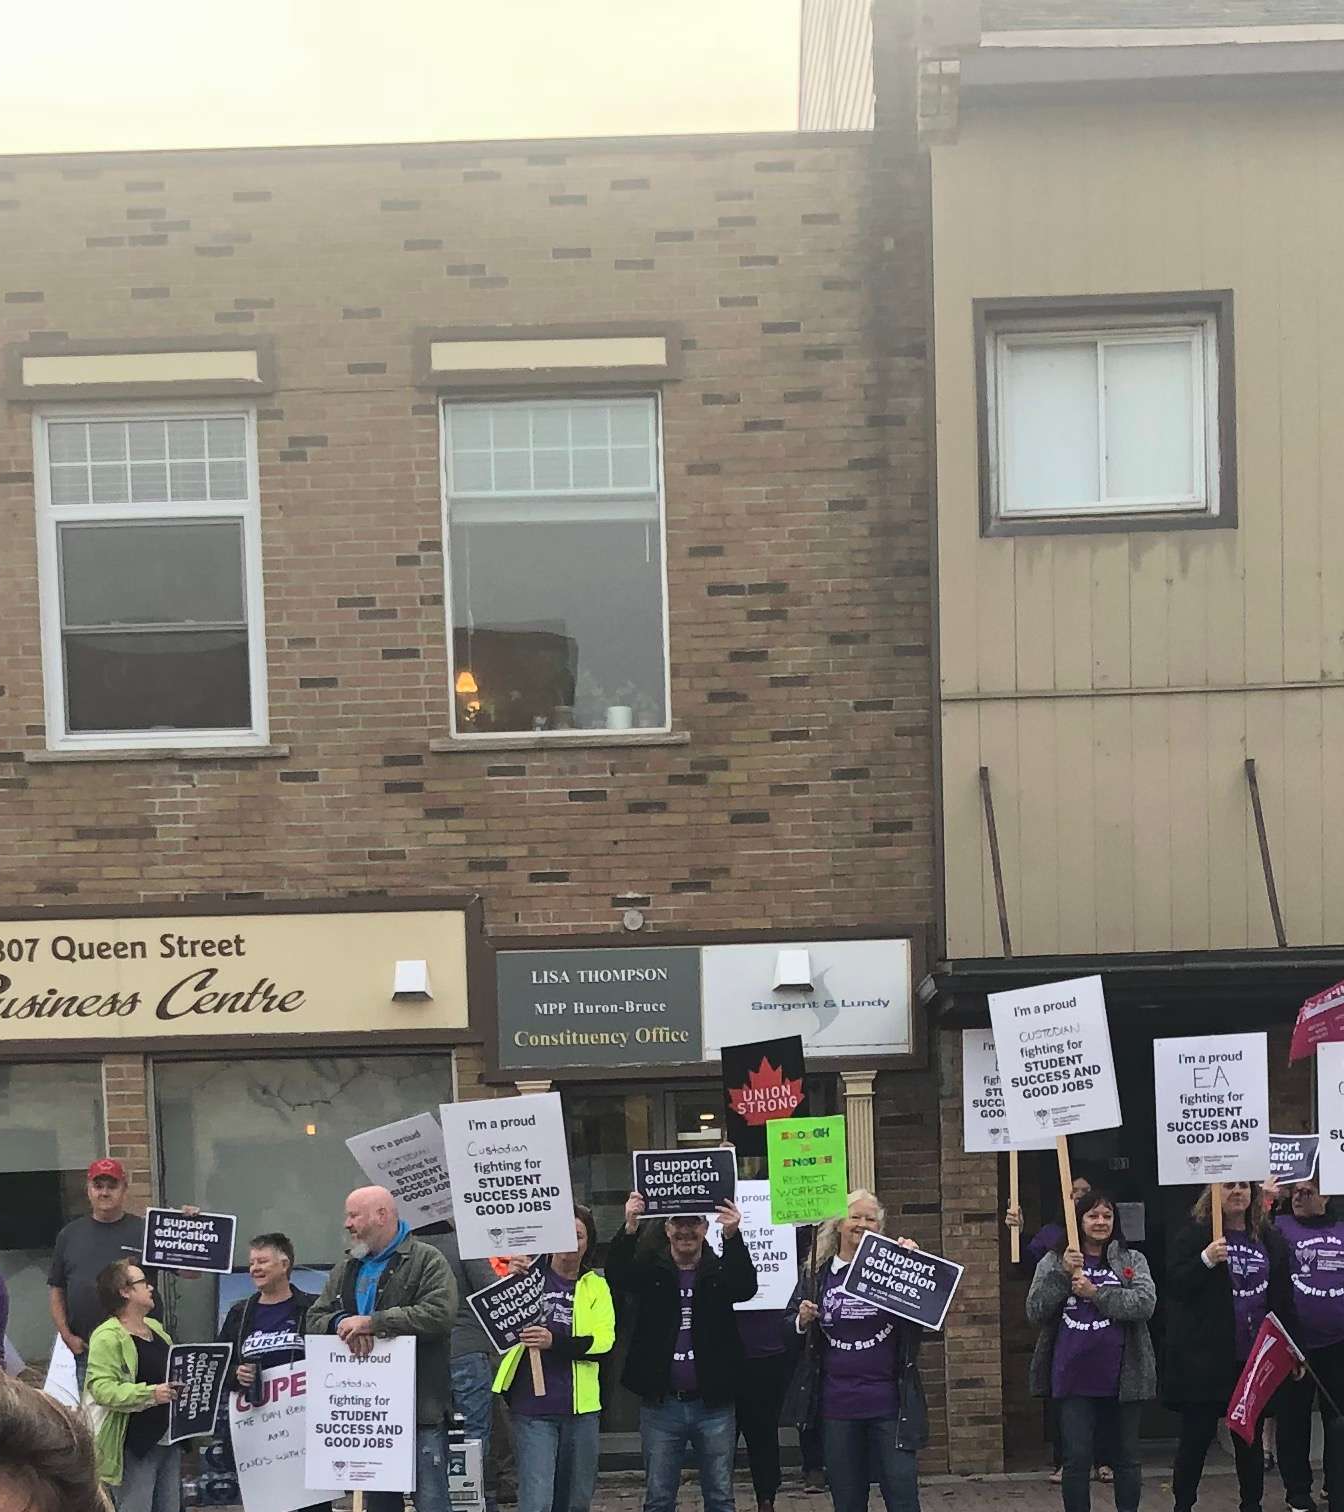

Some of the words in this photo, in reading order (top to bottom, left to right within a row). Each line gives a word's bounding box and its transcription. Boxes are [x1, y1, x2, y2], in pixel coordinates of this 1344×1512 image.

[51, 935, 147, 964] Queen
[159, 933, 246, 959] Street
[531, 970, 570, 984] LISA
[577, 967, 668, 983] THOMPSON
[156, 967, 306, 1020] Centre
[535, 1003, 566, 1015] MPP
[573, 1000, 667, 1014] Huron-Bruce
[751, 1000, 819, 1012] Sargent
[823, 999, 836, 1008] &
[841, 998, 890, 1009] Lundy
[514, 1029, 629, 1048] Constituency
[635, 1027, 689, 1043] Office
[743, 1085, 791, 1102] UNION
[737, 1096, 798, 1115] STRONG
[468, 1118, 488, 1131] I'm
[490, 1120, 499, 1129] a
[500, 1115, 536, 1131] proud
[467, 1141, 529, 1157] Custodian
[473, 1160, 521, 1174] fighting
[524, 1159, 542, 1170] for
[645, 1159, 649, 1171] I
[653, 1157, 712, 1172] support
[783, 1156, 832, 1168] ENOUGH
[478, 1174, 542, 1188] STUDENT
[645, 1170, 720, 1184] education
[463, 1189, 527, 1204] SUCCESS
[531, 1186, 560, 1198] AND
[645, 1183, 709, 1197] workers.
[777, 1184, 837, 1197] WORKERS
[475, 1203, 515, 1216] GOOD
[518, 1200, 551, 1212] JOBS
[155, 1215, 160, 1225] I
[163, 1217, 215, 1232] support
[155, 1227, 219, 1243] education
[154, 1238, 209, 1253] workers.
[869, 1240, 878, 1253] I
[878, 1246, 936, 1277] support
[865, 1256, 937, 1292] education
[860, 1267, 922, 1300] workers.
[244, 1334, 304, 1349] PURPLE
